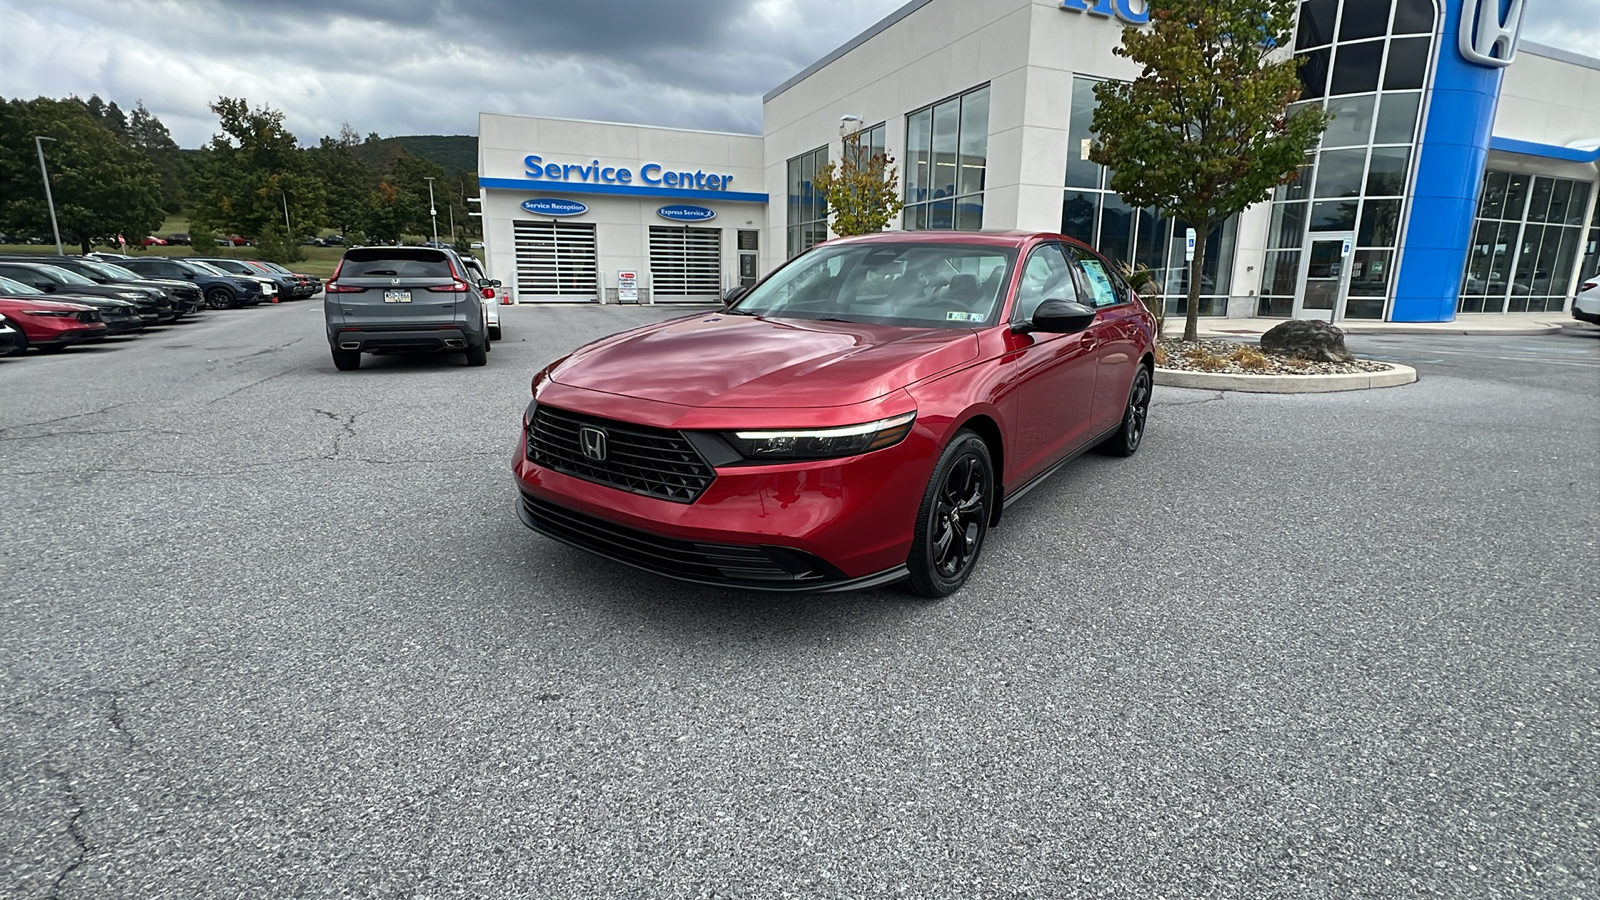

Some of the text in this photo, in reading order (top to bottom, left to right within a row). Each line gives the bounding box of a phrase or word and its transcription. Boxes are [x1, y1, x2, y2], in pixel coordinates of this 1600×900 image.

[524, 155, 733, 190] Service Center
[551, 203, 584, 211] Reception
[660, 208, 705, 217] Express Service
